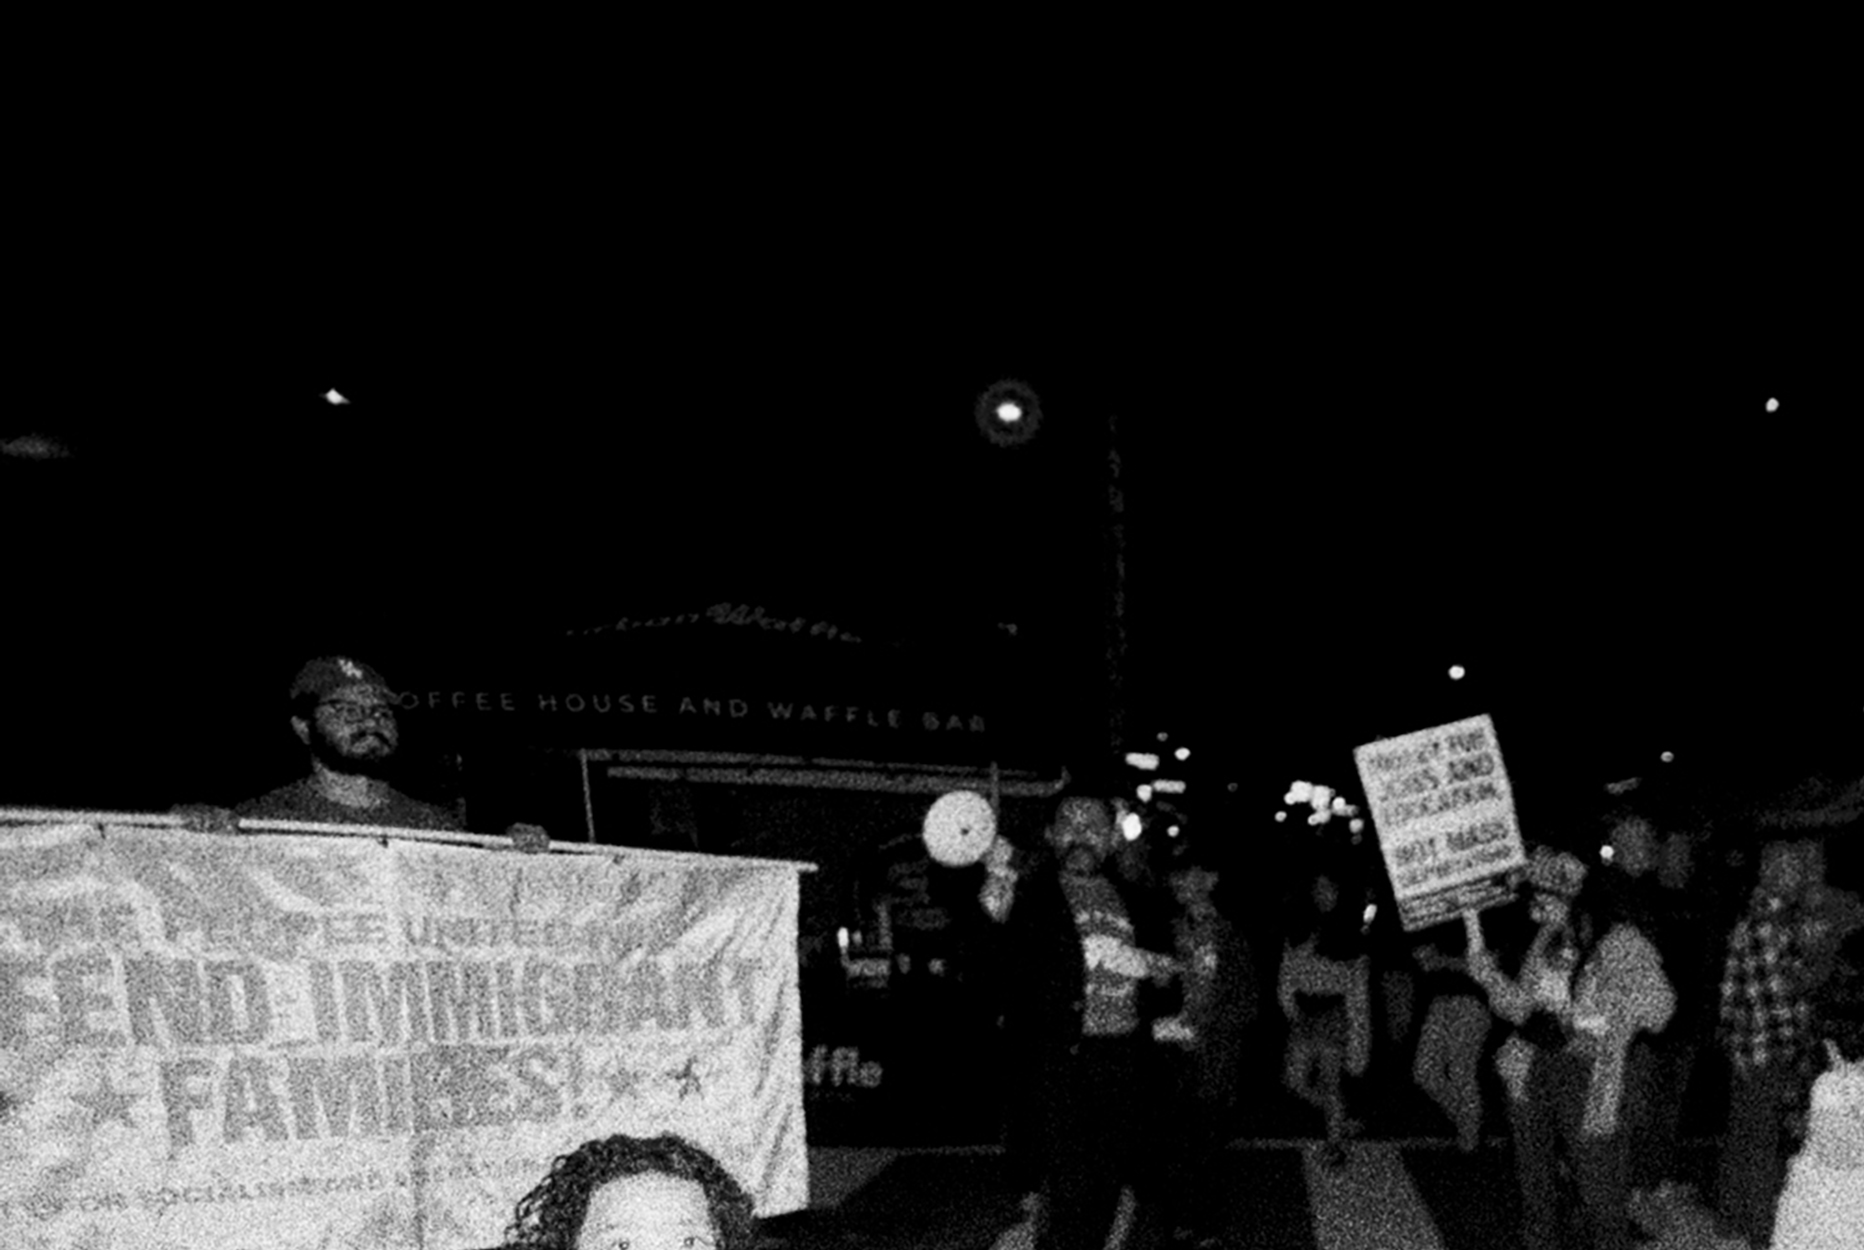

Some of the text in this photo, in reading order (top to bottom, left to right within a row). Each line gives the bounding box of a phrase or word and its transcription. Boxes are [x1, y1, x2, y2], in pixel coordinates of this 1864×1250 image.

[398, 691, 986, 732] OFFEE HOUSE AND WAFFLE BAR
[1448, 753, 1496, 785] AND
[307, 958, 762, 1043] IMMIGRANT
[802, 1044, 884, 1090] ffle
